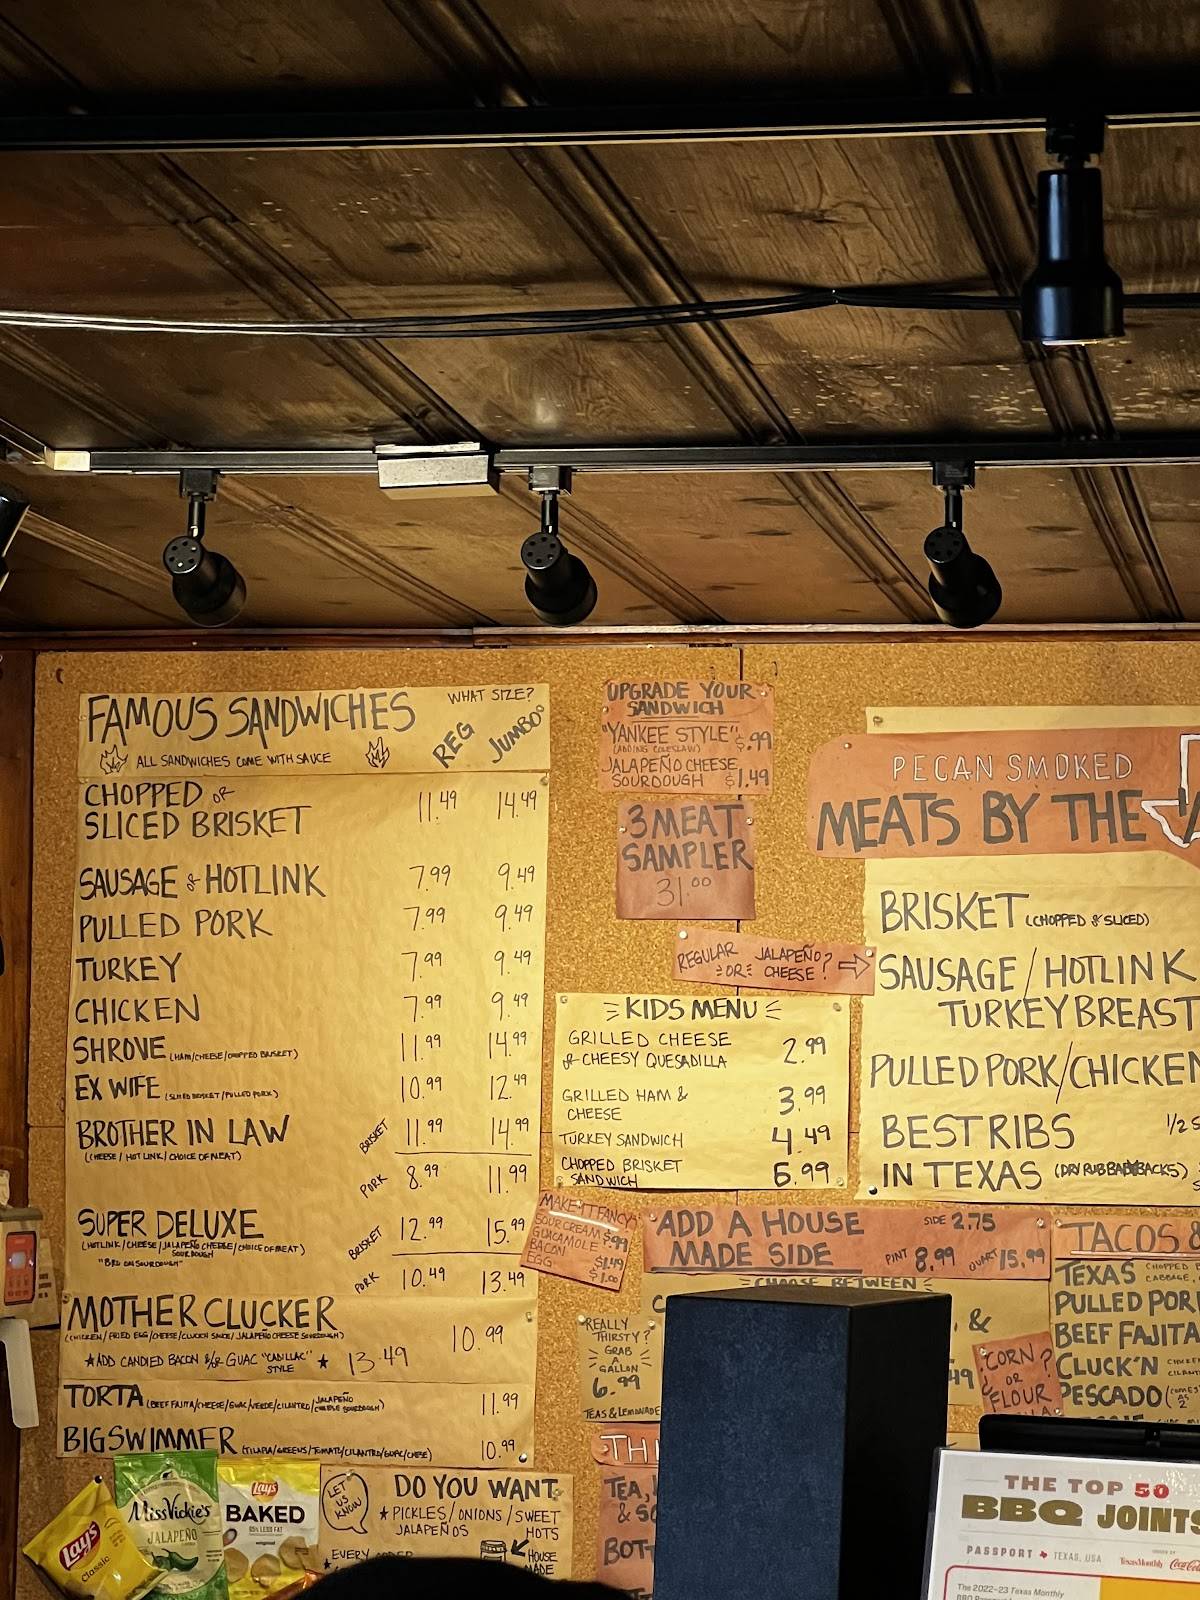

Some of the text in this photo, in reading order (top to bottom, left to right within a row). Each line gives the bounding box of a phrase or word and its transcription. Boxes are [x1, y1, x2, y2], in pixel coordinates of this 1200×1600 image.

[447, 688, 534, 704] WHAT SIZE?
[607, 682, 757, 700] UPGRADE YOUR
[88, 691, 416, 749] FAMOUS SANDWICHES
[626, 700, 724, 717] SANDWICH
[432, 722, 475, 769] REG
[602, 722, 738, 744] "YANKEE STYLE"
[735, 731, 773, 752] $.99
[136, 752, 331, 768] ALL SANDWICHES COME WITH SAUCE
[601, 753, 738, 774] JALAPEÑO CHEESE
[892, 752, 1133, 782] PECAN SMOKED
[611, 774, 704, 788] SOURDOUGH
[725, 768, 770, 789] $1.49
[85, 781, 202, 807] CHOPPED
[419, 790, 537, 823] 11.49 14.49
[85, 806, 311, 840] SLICED BRISKET
[627, 804, 744, 839] 3 MEAT
[816, 792, 961, 853] MEATS
[982, 790, 1041, 844] BY
[1051, 789, 1147, 844] THE
[621, 838, 754, 872] SAMPLER
[80, 863, 326, 900] SAUSAGE HOTLINK
[656, 876, 712, 907] 31.00
[880, 890, 1150, 933] BRISKET (CHOPPED SLICED)
[80, 908, 273, 942] PULLED PORK
[76, 952, 182, 983] TURKEY
[677, 941, 739, 973] REGULAR
[725, 965, 746, 979] OR
[764, 966, 814, 981] CHEESE
[75, 994, 200, 1025] CHICKEN
[626, 997, 758, 1020] KIDS MENU
[937, 994, 1200, 1031] TURKEY BREAST
[73, 1036, 166, 1064] SHROVE
[568, 1030, 732, 1047] GRILLED CHEESE
[782, 1036, 827, 1065] 2.99
[582, 1051, 727, 1069] CHEESY QUESADILLA
[870, 1053, 979, 1088] PULLED
[75, 1074, 161, 1100] EX WIFE
[562, 1085, 688, 1102] GRILLED HAM &
[778, 1085, 826, 1116] 3.99
[567, 1107, 622, 1122] CHEESE
[76, 1114, 290, 1149] BROTHER IN LAW
[558, 1131, 683, 1148] TURKEY SANDWICH
[771, 1124, 831, 1156] 4.49
[881, 1113, 1075, 1150] BEST RIBS
[561, 1157, 683, 1173] CHOPPED BRISKET
[883, 1162, 912, 1188] IN
[923, 1160, 1042, 1192] TEXAS
[1083, 1163, 1106, 1176] RUB
[359, 1173, 389, 1199] PORK
[570, 1173, 638, 1188] SANDWICH
[77, 1208, 264, 1239] SUPER DELUXE
[535, 1213, 600, 1239] SOUR CREAM
[656, 1209, 864, 1238] ADD A HOUSE
[924, 1211, 996, 1232] SIDE 2.75
[348, 1225, 382, 1261] BRISKET
[1060, 1221, 1180, 1253] TACOS
[526, 1250, 552, 1267] EGG
[669, 1241, 834, 1267] MADE SIDE
[885, 1246, 955, 1273] PINT 8.99
[968, 1247, 1045, 1272] QUART 15.99
[354, 1271, 380, 1294] PORK
[831, 1277, 917, 1290] BETWEEN
[1055, 1260, 1136, 1286] TEXAS
[67, 1294, 338, 1332] MOTHER CLUCKER
[1055, 1291, 1143, 1316] PULLED
[585, 1317, 629, 1331] REALLY
[969, 1307, 992, 1333] &
[1055, 1322, 1113, 1349] BEEF
[96, 1352, 258, 1367] ADD CANDIED BACON GUAC
[604, 1345, 633, 1356] GRAB
[611, 1356, 620, 1365] A
[266, 1364, 294, 1374] STYLE
[599, 1364, 639, 1374] GALLON
[1056, 1352, 1158, 1379] CLUCK'N
[592, 1374, 641, 1398] 6.99
[1005, 1373, 1023, 1385] OR
[63, 1384, 144, 1408] TORTA
[989, 1383, 1052, 1412] FLOUR
[1059, 1382, 1162, 1407] PESCADO
[584, 1407, 618, 1420] TEAS &
[326, 1480, 346, 1498] LET
[394, 1474, 559, 1502] DO YOU WANT
[1004, 1474, 1170, 1500] THE TOP 50
[162, 1493, 213, 1525] Vickie's
[334, 1497, 363, 1520] KNOW
[335, 1494, 349, 1508] US
[617, 1502, 631, 1524] &
[961, 1494, 1083, 1527] BBQ
[226, 1504, 305, 1524] BAKED
[147, 1528, 198, 1545] JALAPEÑO
[395, 1521, 469, 1537] JALAPEÑOS
[526, 1527, 559, 1540] HOTS
[331, 1548, 370, 1560] EVERY
[528, 1548, 557, 1562] HOUSE
[966, 1545, 1033, 1559] PASSPORT
[1085, 1554, 1102, 1564] USA
[81, 1555, 110, 1582] Classic
[957, 1583, 971, 1592] The
[1033, 1588, 1065, 1598] Monthly
